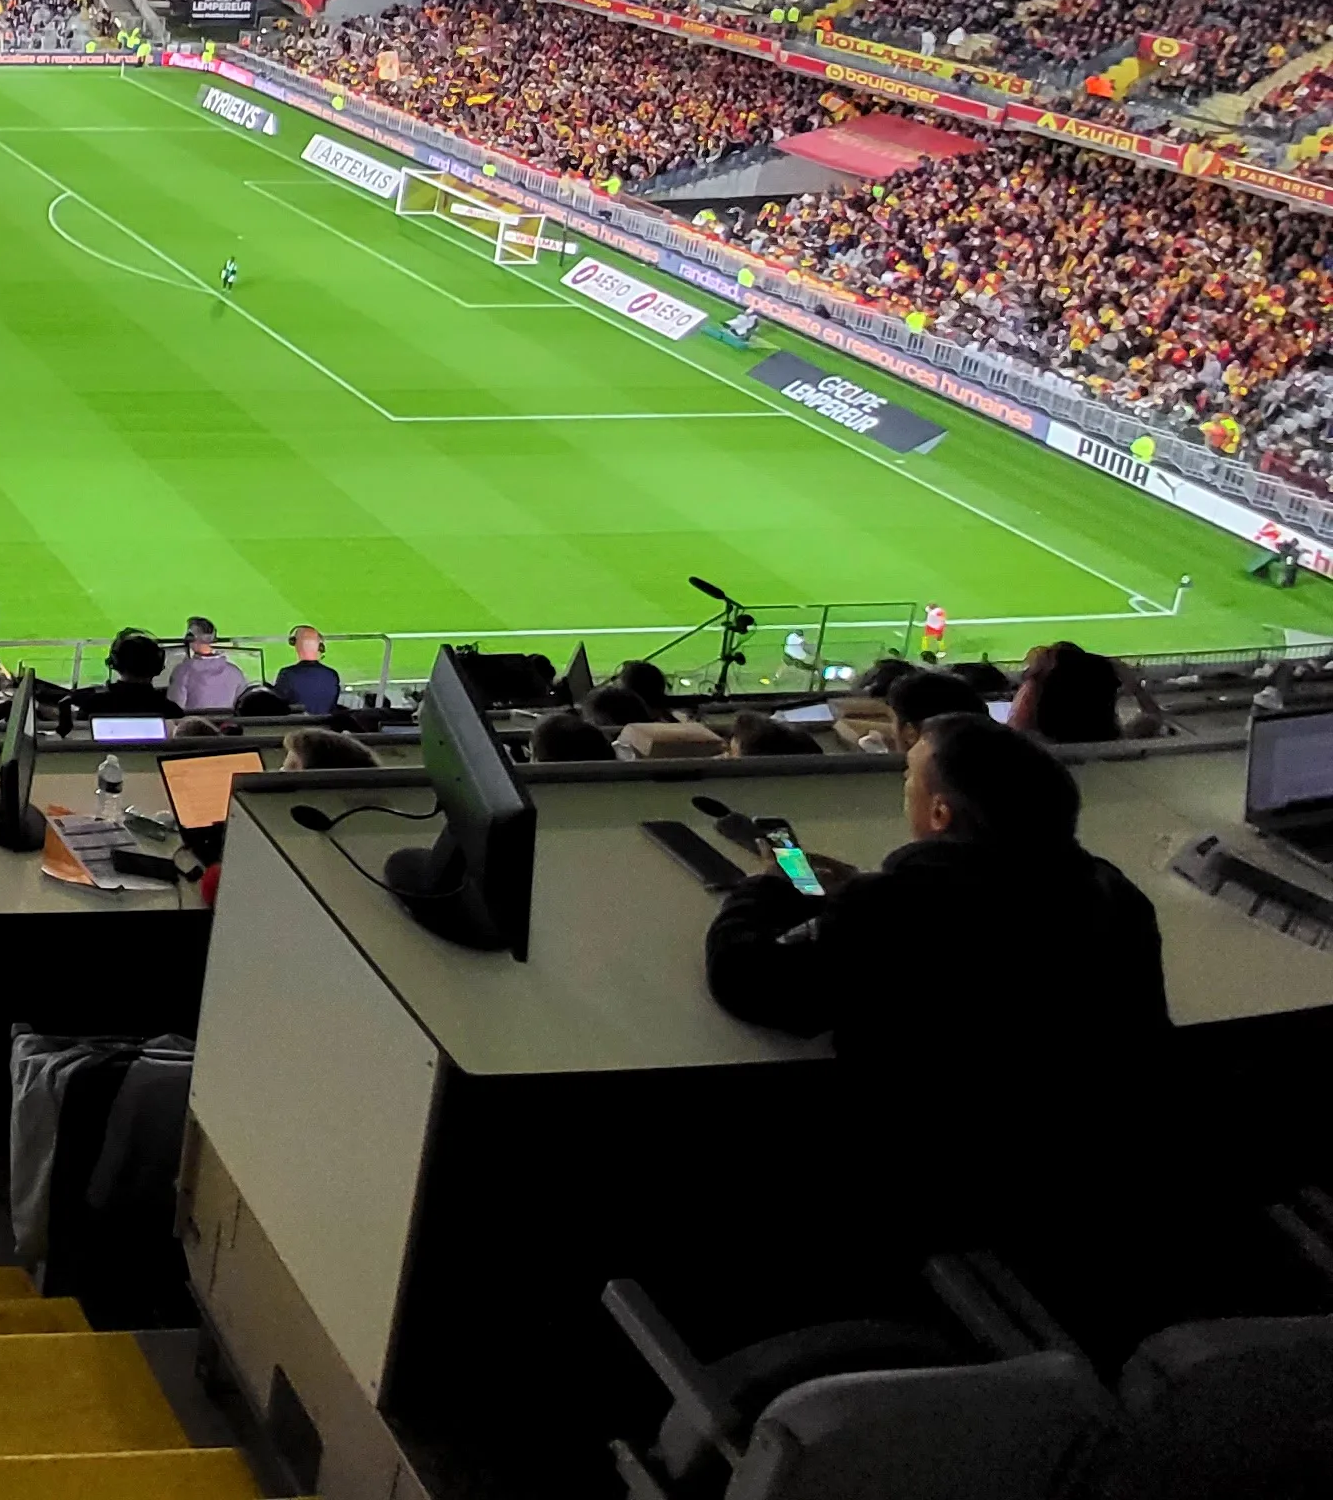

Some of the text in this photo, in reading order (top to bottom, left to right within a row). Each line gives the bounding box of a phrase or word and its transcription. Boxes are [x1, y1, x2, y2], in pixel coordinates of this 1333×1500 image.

[192, 1, 251, 12] LEMPEREUR
[844, 67, 939, 104] boulanger
[201, 87, 261, 129] KYRIELYS
[1062, 118, 1138, 151] Azurial
[318, 143, 393, 191] ARTEMIS
[600, 218, 659, 263] humaines
[679, 262, 1032, 429] randstad, spécialiste en ressources humaines
[781, 380, 880, 434] LEMPEREUR
[818, 376, 888, 413] GROUPE
[1078, 437, 1150, 487] PUMA
